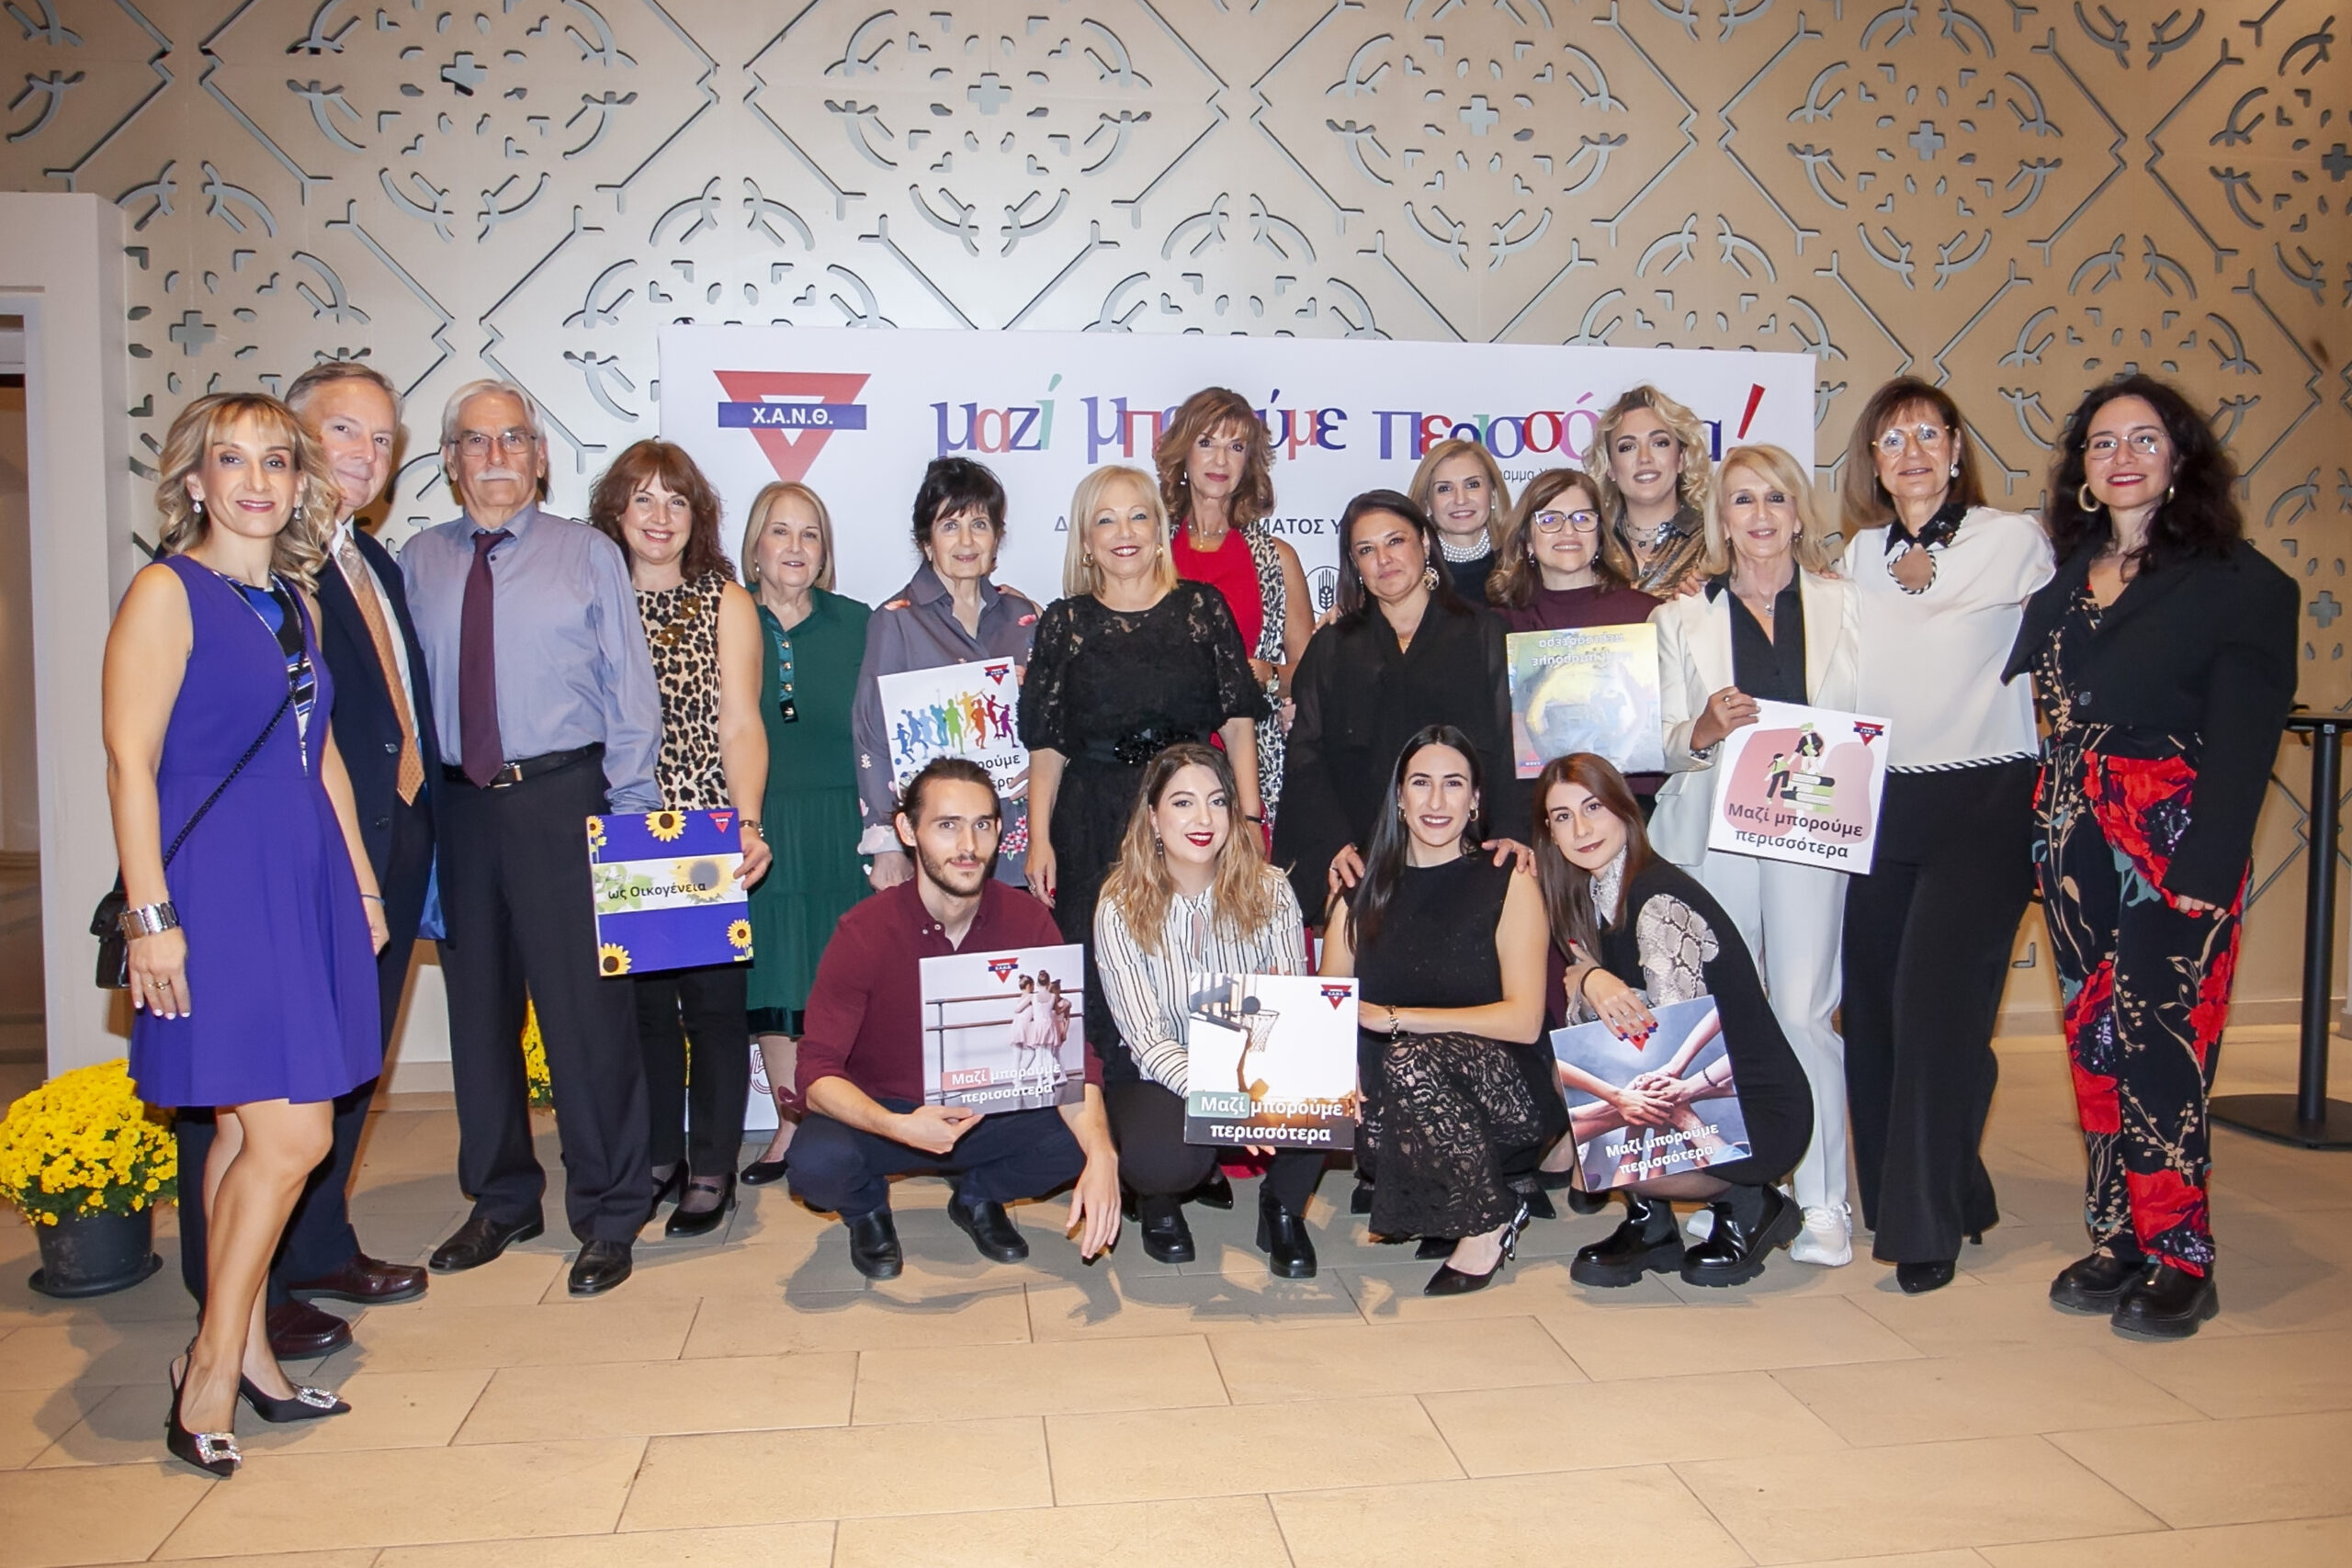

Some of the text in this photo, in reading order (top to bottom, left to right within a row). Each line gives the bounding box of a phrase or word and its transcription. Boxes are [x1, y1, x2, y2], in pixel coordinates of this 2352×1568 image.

[1728, 803, 1863, 838] Μαζί μπορούμε
[1735, 829, 1849, 859] περισσότερα
[608, 882, 707, 901] ως Οικογένεια
[952, 1063, 1061, 1086] Μαζί μπορούμε
[960, 1084, 1054, 1104] περισσότερα
[1200, 1096, 1343, 1120] Μαζί μπορούμε
[1210, 1122, 1331, 1145] περισσότερα
[1605, 1123, 1720, 1158] Μαζί μπορούμε
[1619, 1145, 1714, 1175] περισσότερα
